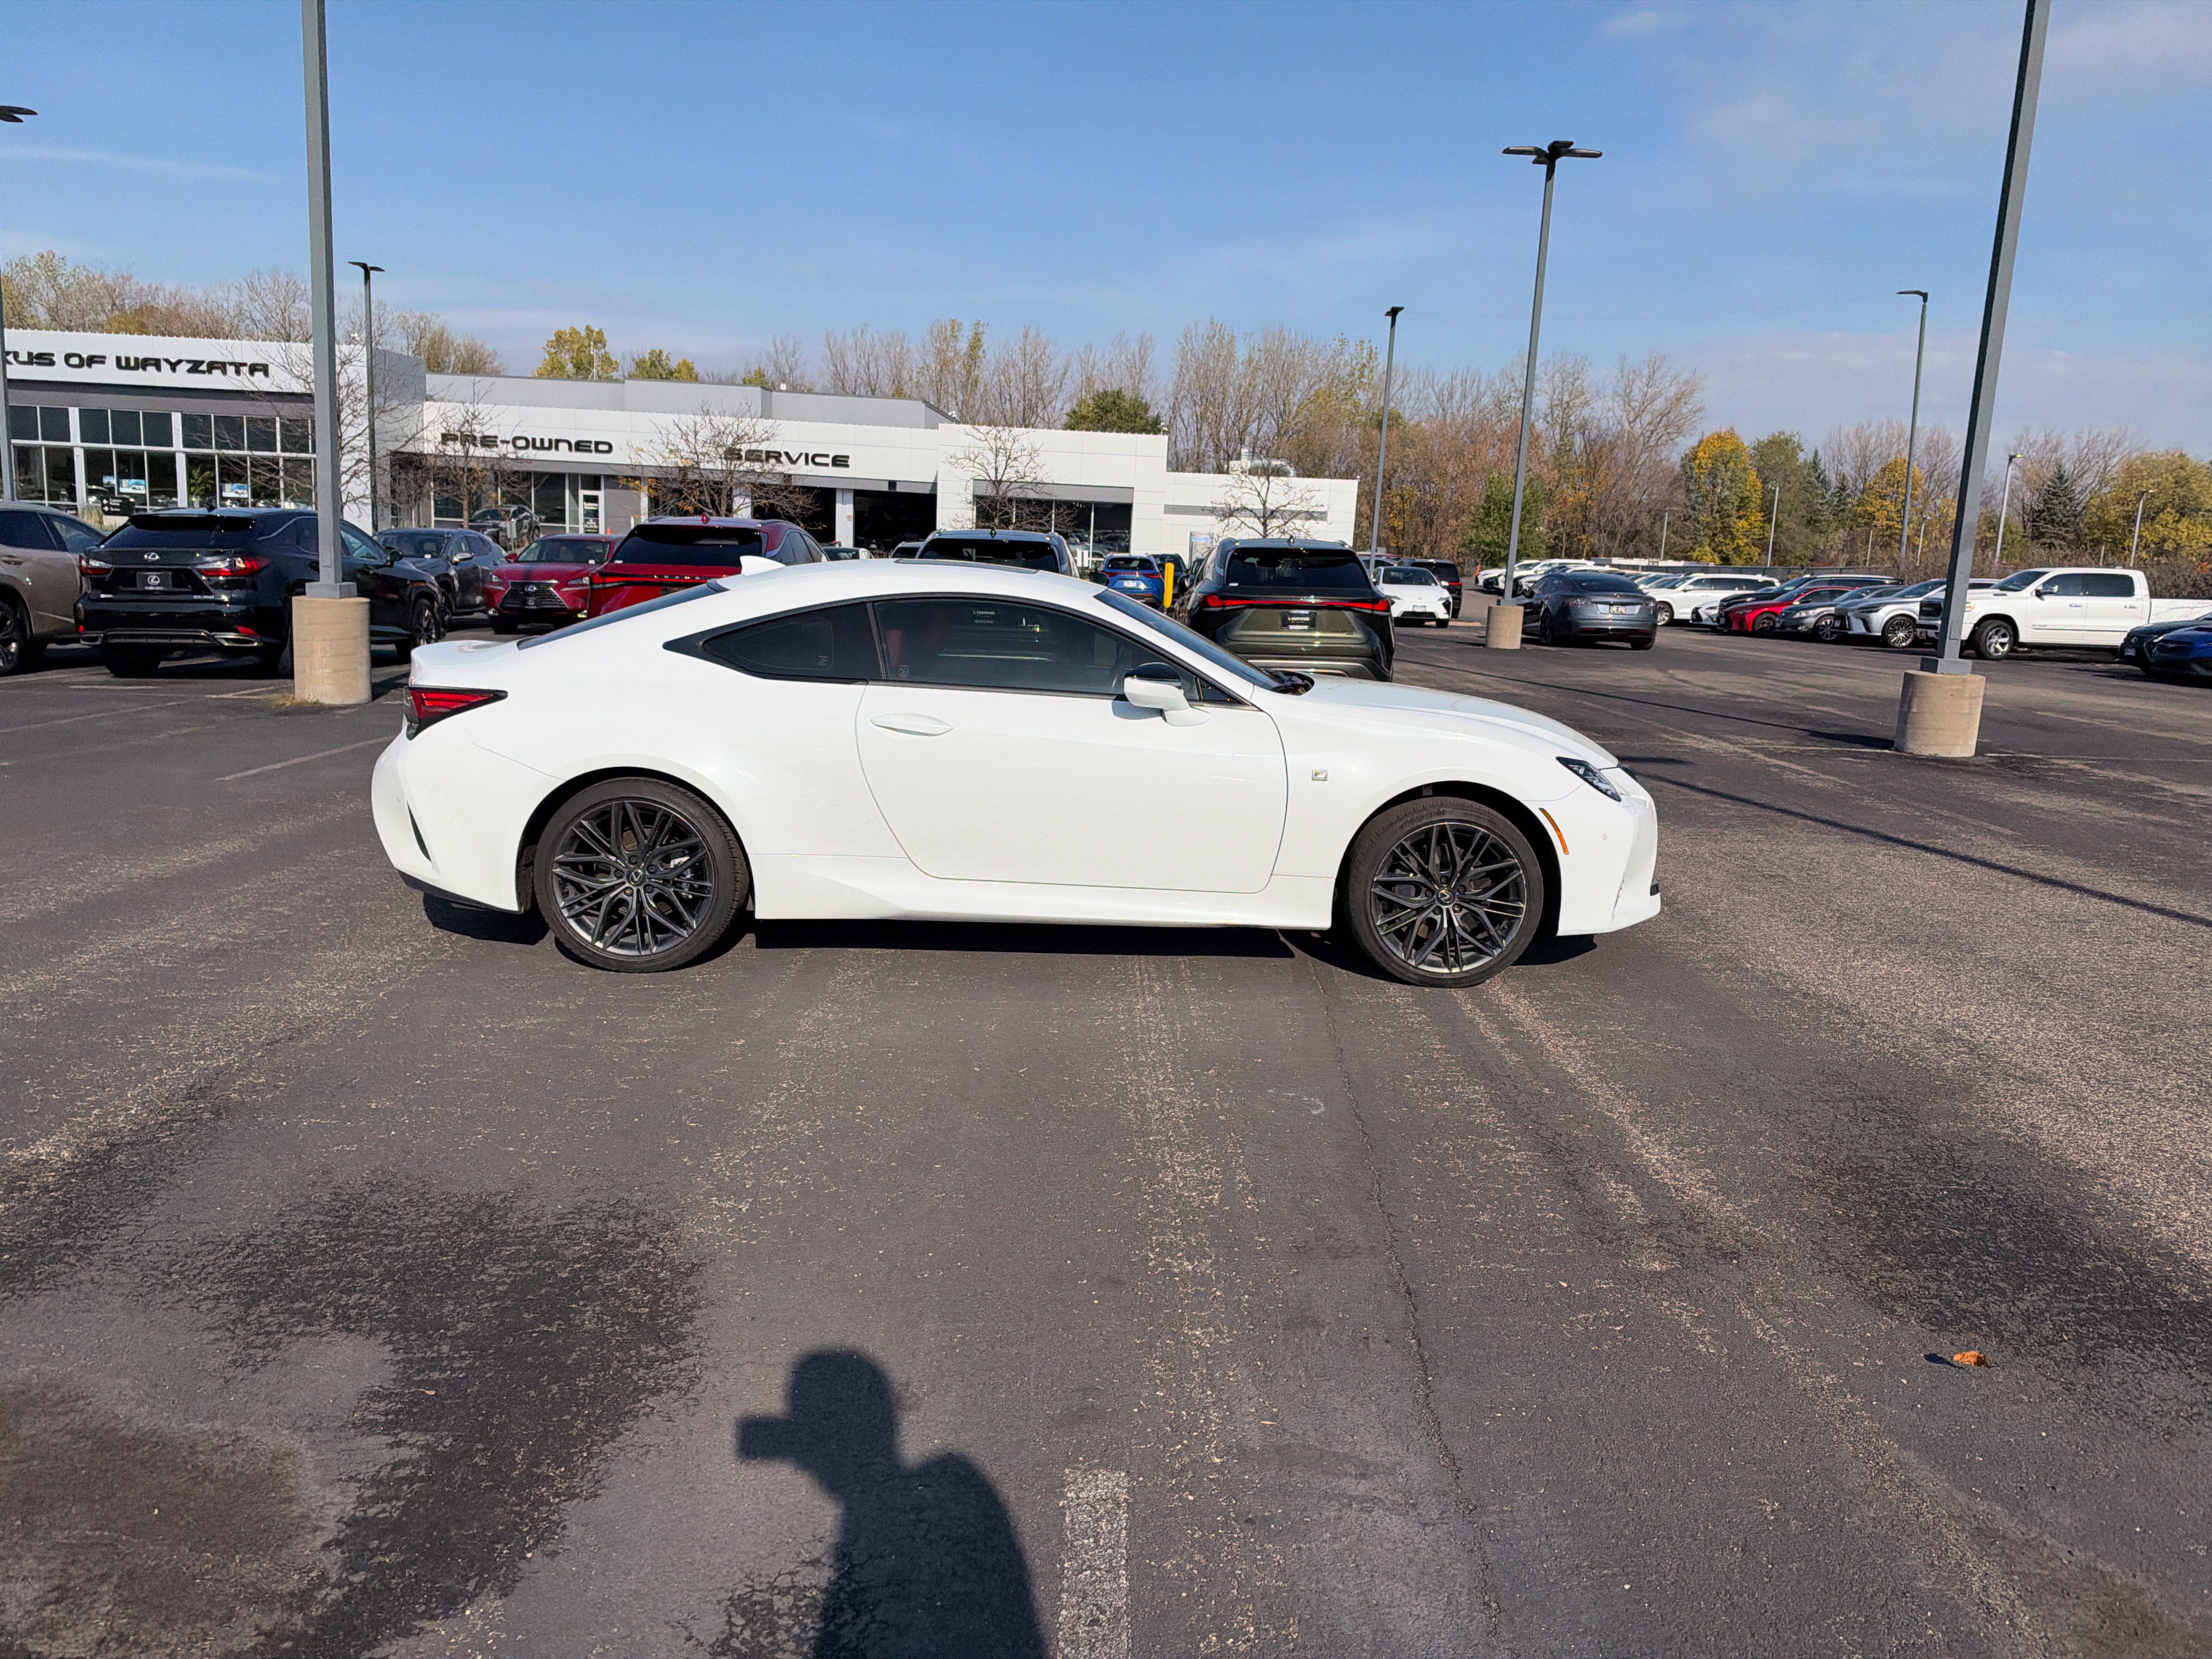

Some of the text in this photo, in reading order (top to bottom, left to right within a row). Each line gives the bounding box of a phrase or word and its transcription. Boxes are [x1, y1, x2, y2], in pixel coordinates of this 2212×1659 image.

[64, 353, 106, 369] OF
[115, 356, 269, 378] WAYZATA
[441, 432, 613, 454] PRE-OWNED
[723, 448, 850, 469] SERVICE
